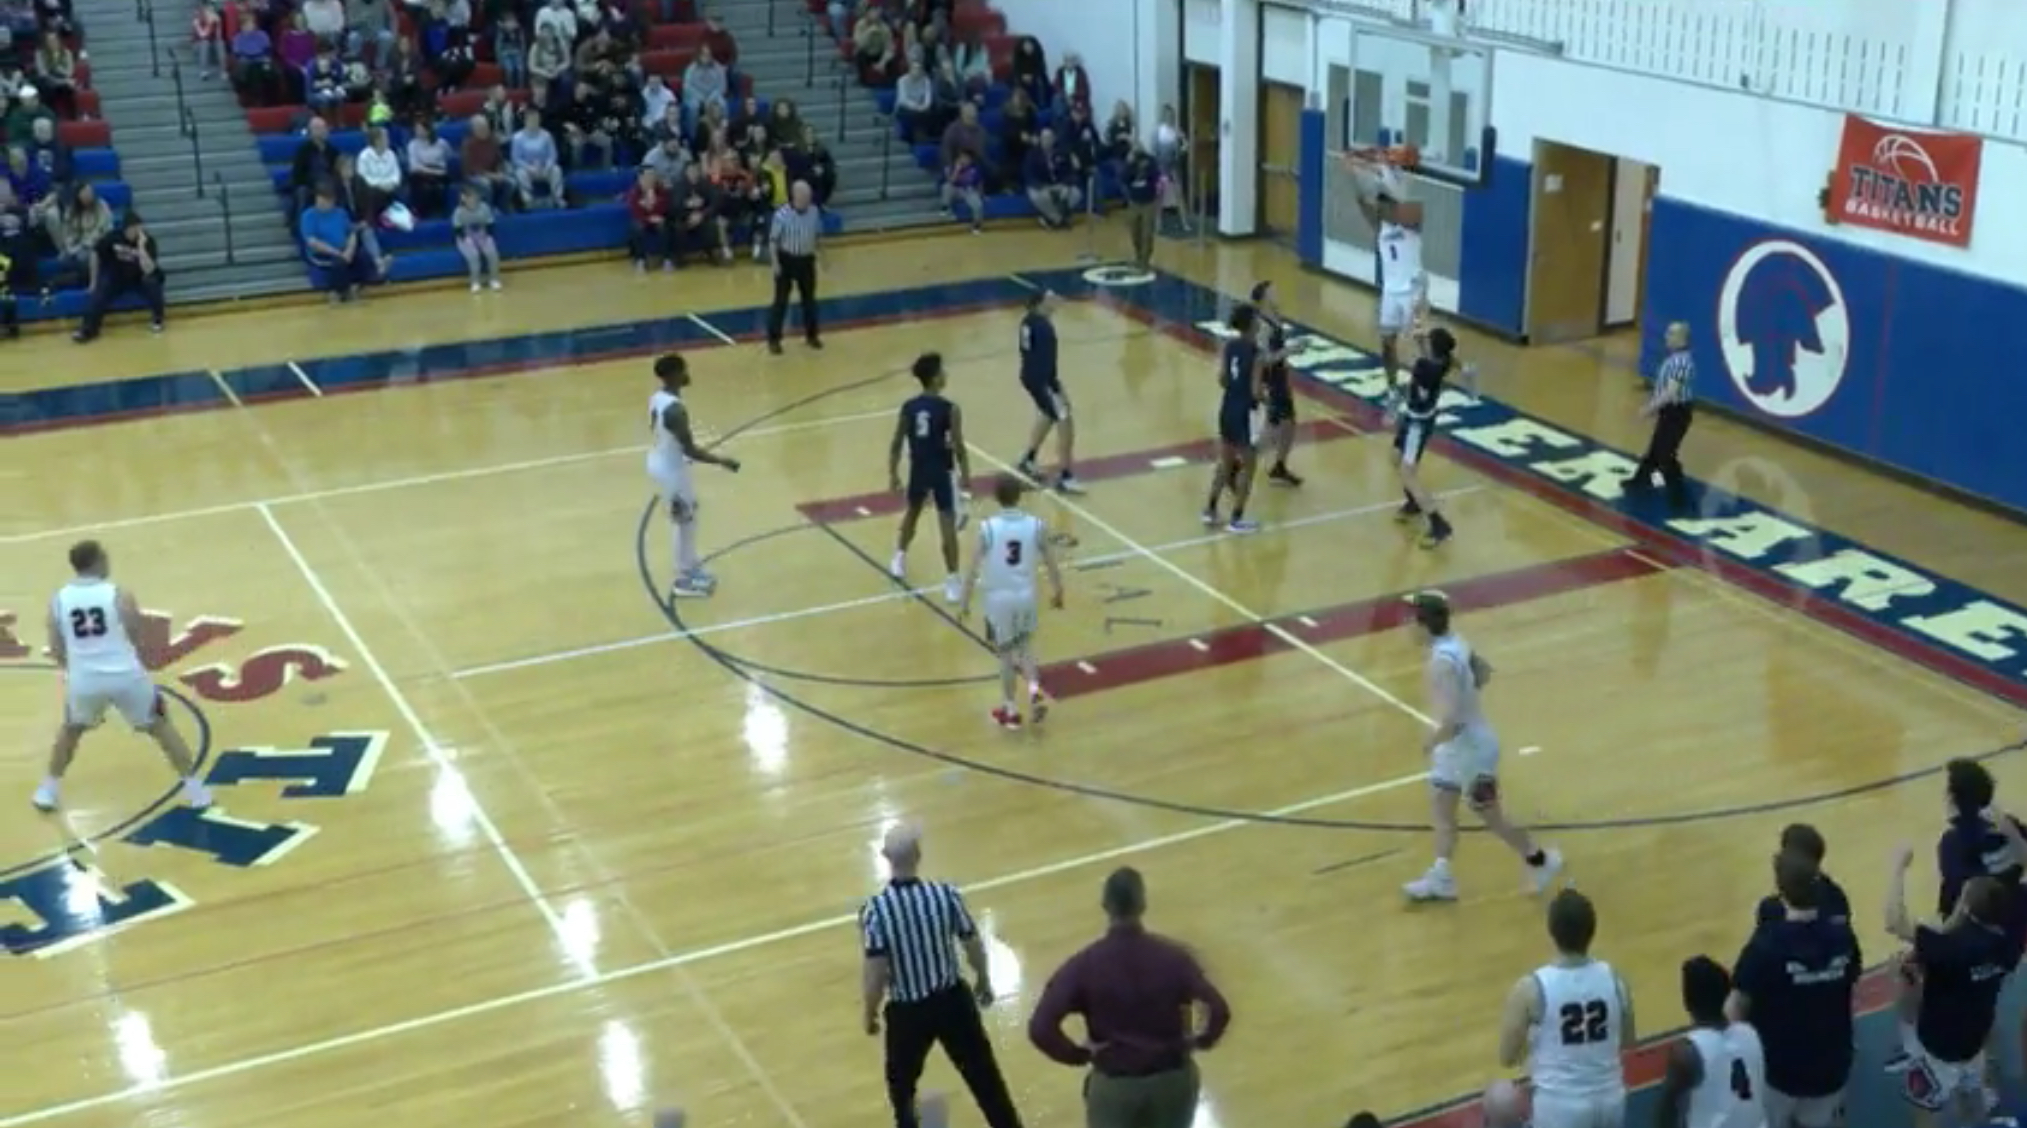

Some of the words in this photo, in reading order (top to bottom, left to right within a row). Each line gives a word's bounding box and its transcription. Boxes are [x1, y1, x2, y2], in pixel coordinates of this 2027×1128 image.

[1852, 164, 1963, 219] TITANS
[1844, 198, 1961, 236] BASKETBALL
[1195, 320, 1640, 499] HAER
[1665, 510, 2027, 677] ARE
[1006, 540, 1022, 566] 3
[71, 607, 107, 638] 23
[1560, 999, 1608, 1044] 22
[1730, 1057, 1752, 1101] 4
